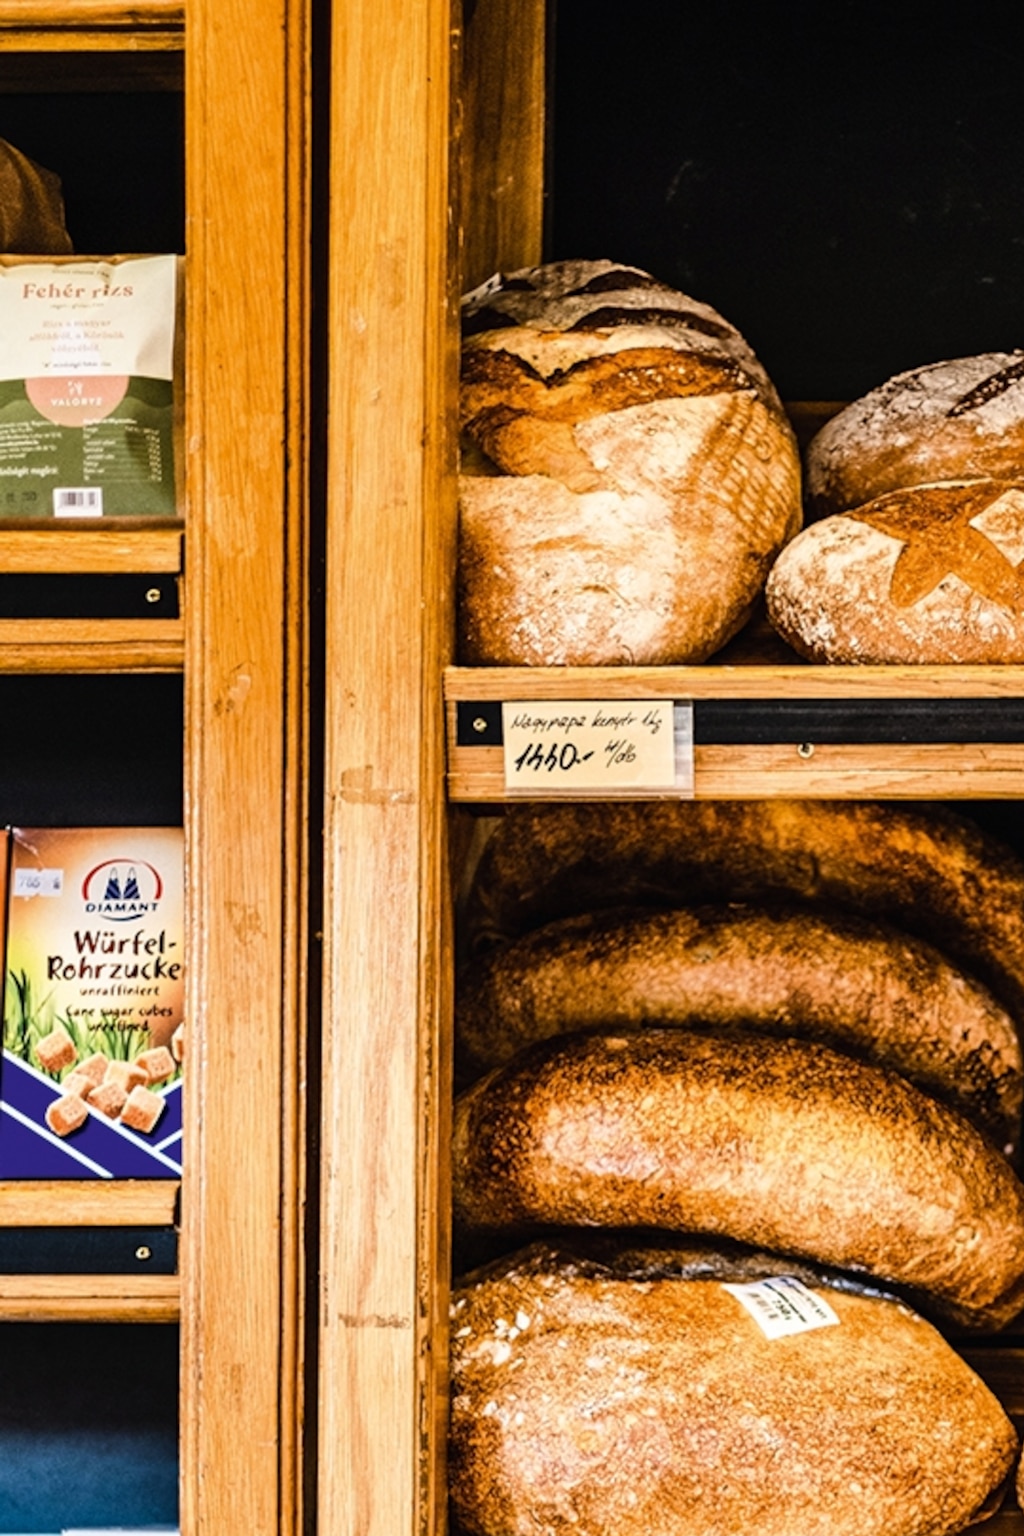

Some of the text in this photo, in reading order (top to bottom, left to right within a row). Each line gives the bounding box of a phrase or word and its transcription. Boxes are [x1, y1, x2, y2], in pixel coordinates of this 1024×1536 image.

[22, 281, 134, 299] Fehér rizs
[85, 902, 159, 913] DIAMANT
[74, 929, 177, 956] Würfel-
[47, 955, 184, 980] Rohrzucke
